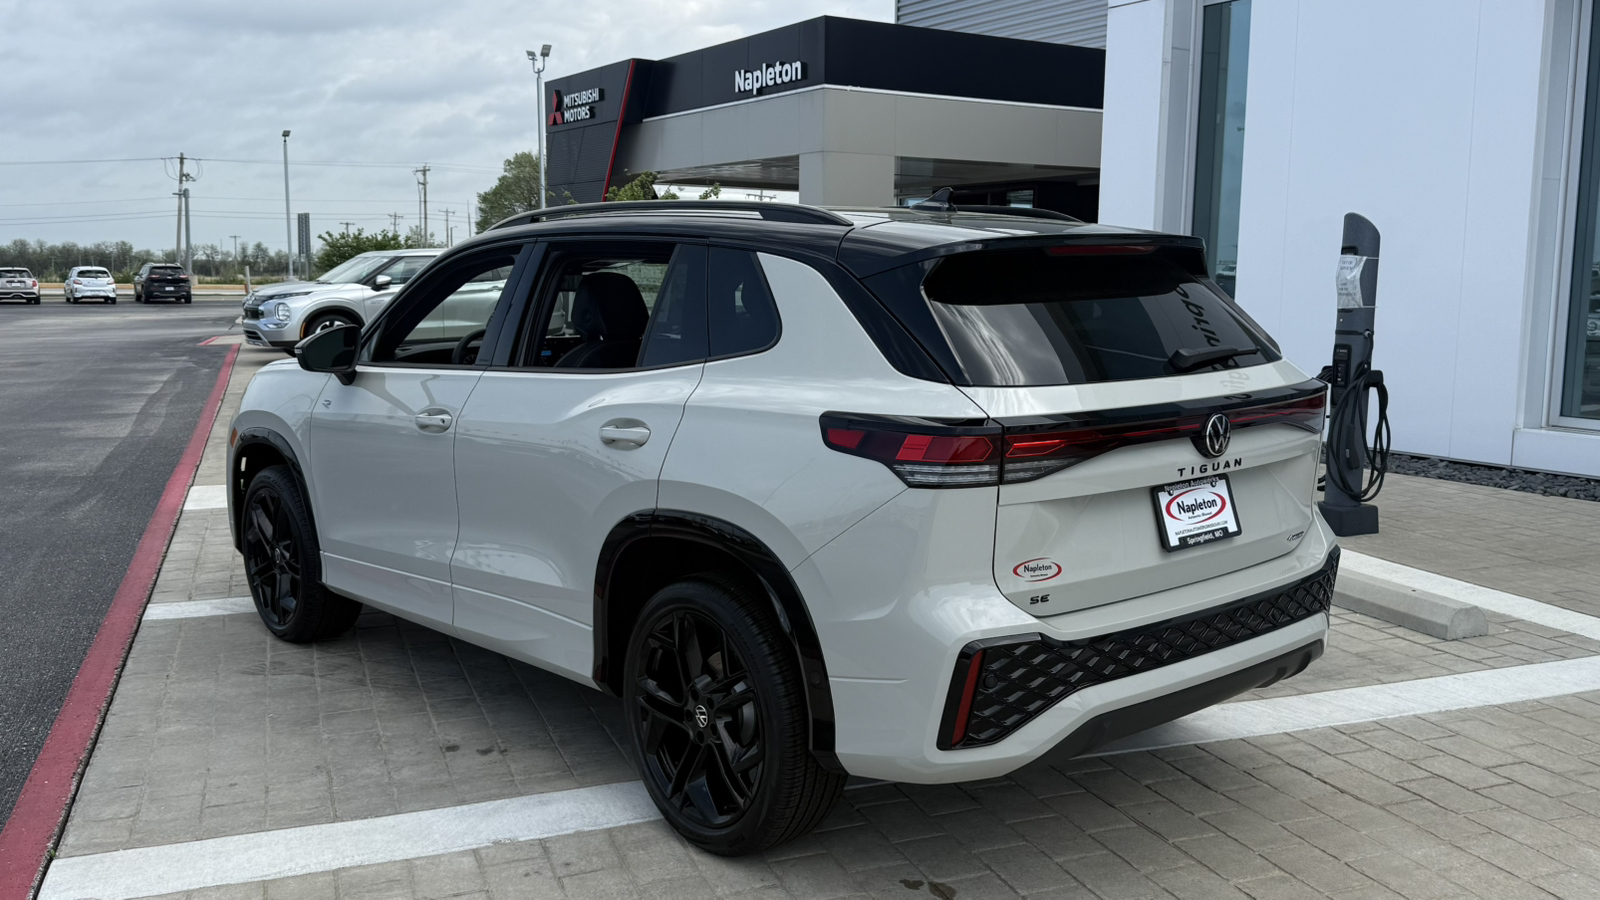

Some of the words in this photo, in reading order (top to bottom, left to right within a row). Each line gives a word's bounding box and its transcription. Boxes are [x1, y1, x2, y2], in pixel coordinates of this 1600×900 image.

[734, 61, 801, 94] Napleton
[563, 88, 599, 107] MITSUBISHI
[564, 106, 590, 123] MOTORS
[1177, 458, 1242, 477] TIGUAN
[1176, 498, 1217, 515] Napleton
[1187, 533, 1215, 545] Springfield,
[1214, 530, 1223, 538] MO
[1023, 563, 1052, 573] Napleton
[1029, 593, 1050, 605] SE
